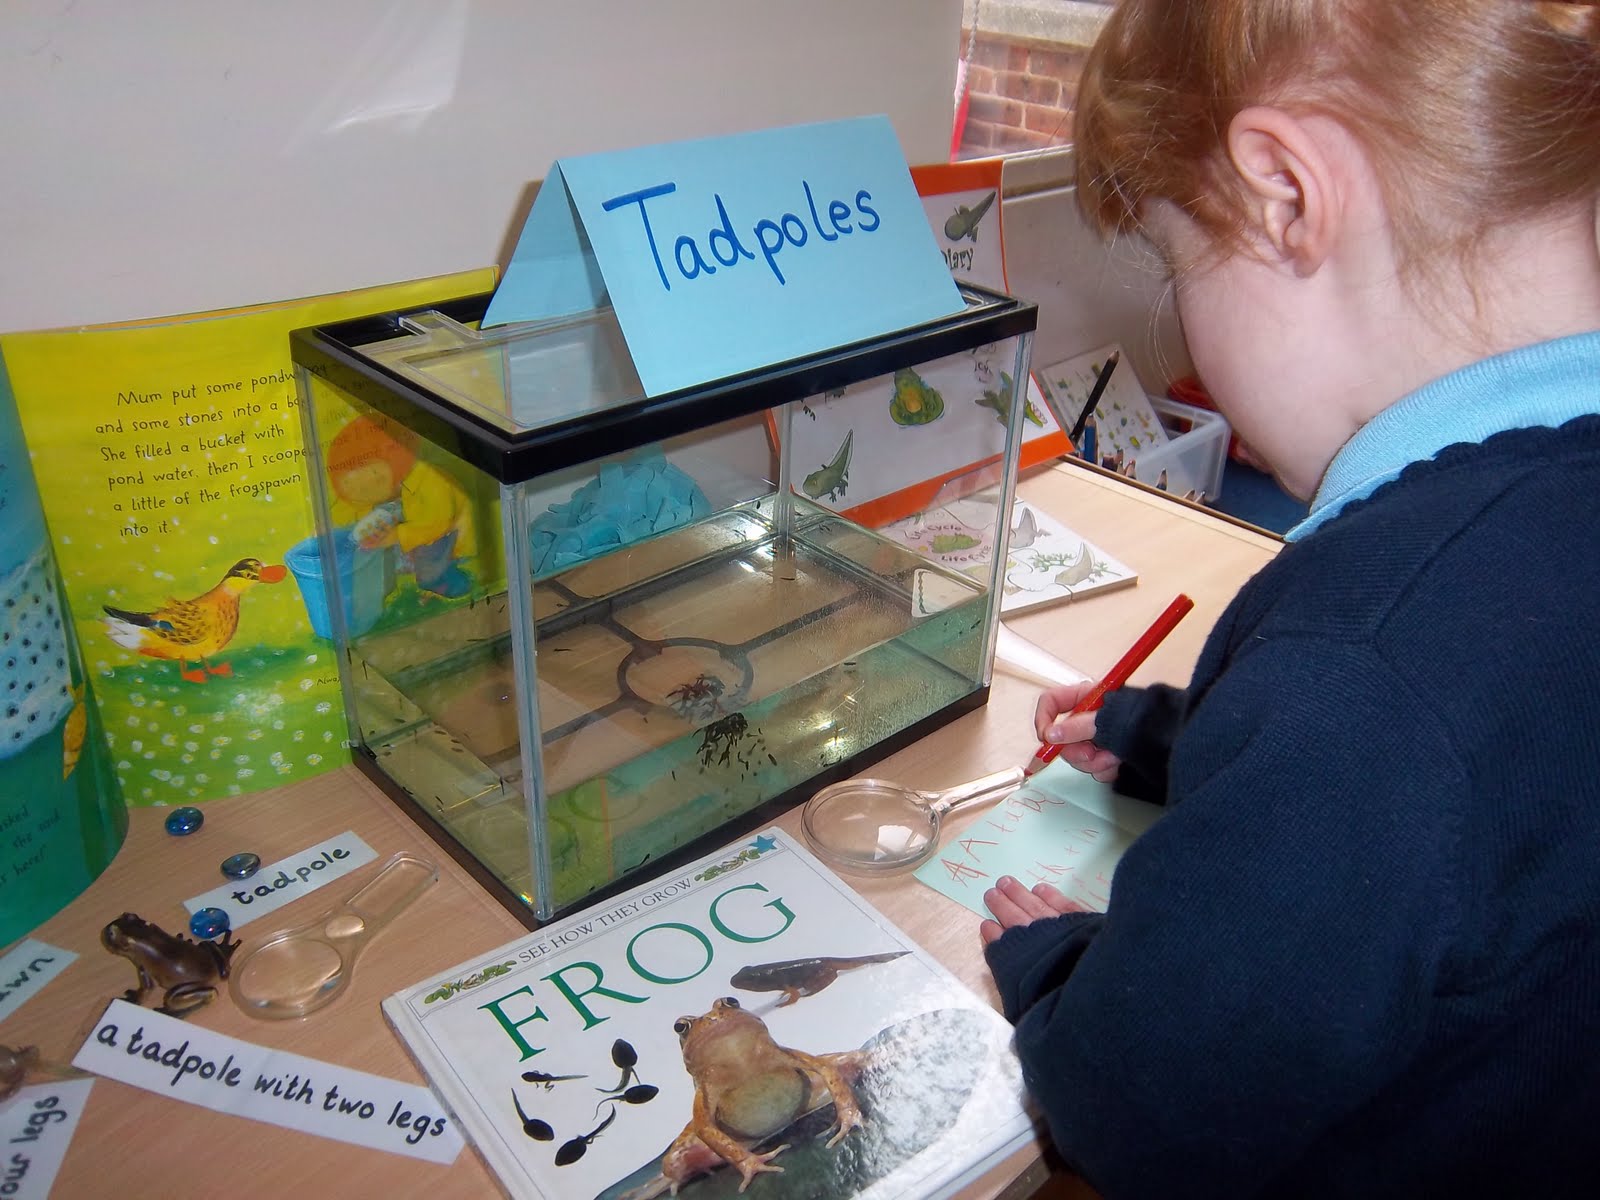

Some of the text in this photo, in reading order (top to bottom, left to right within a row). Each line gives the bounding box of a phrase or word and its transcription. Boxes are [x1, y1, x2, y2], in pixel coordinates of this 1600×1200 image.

[601, 179, 881, 292] Tadpoles
[117, 390, 163, 407] Mum
[172, 383, 197, 406] put
[206, 381, 243, 396] some
[251, 368, 296, 393] pondw
[95, 418, 124, 434] and
[132, 419, 171, 432] some
[178, 409, 224, 427] stones
[232, 402, 261, 419] into
[269, 402, 279, 411] a
[100, 423, 285, 462] She filled a bucket with
[107, 470, 145, 492] pond
[207, 461, 239, 476] then
[246, 454, 255, 469] I
[113, 473, 301, 512] a little of the frogspawn
[119, 522, 149, 537] into
[231, 848, 351, 905] tadpole
[518, 877, 692, 964] SEE HOW THEY GROW
[477, 881, 798, 1063] FROG
[96, 1024, 447, 1145] a tadpole with two legs
[0, 1095, 68, 1200] our legs
